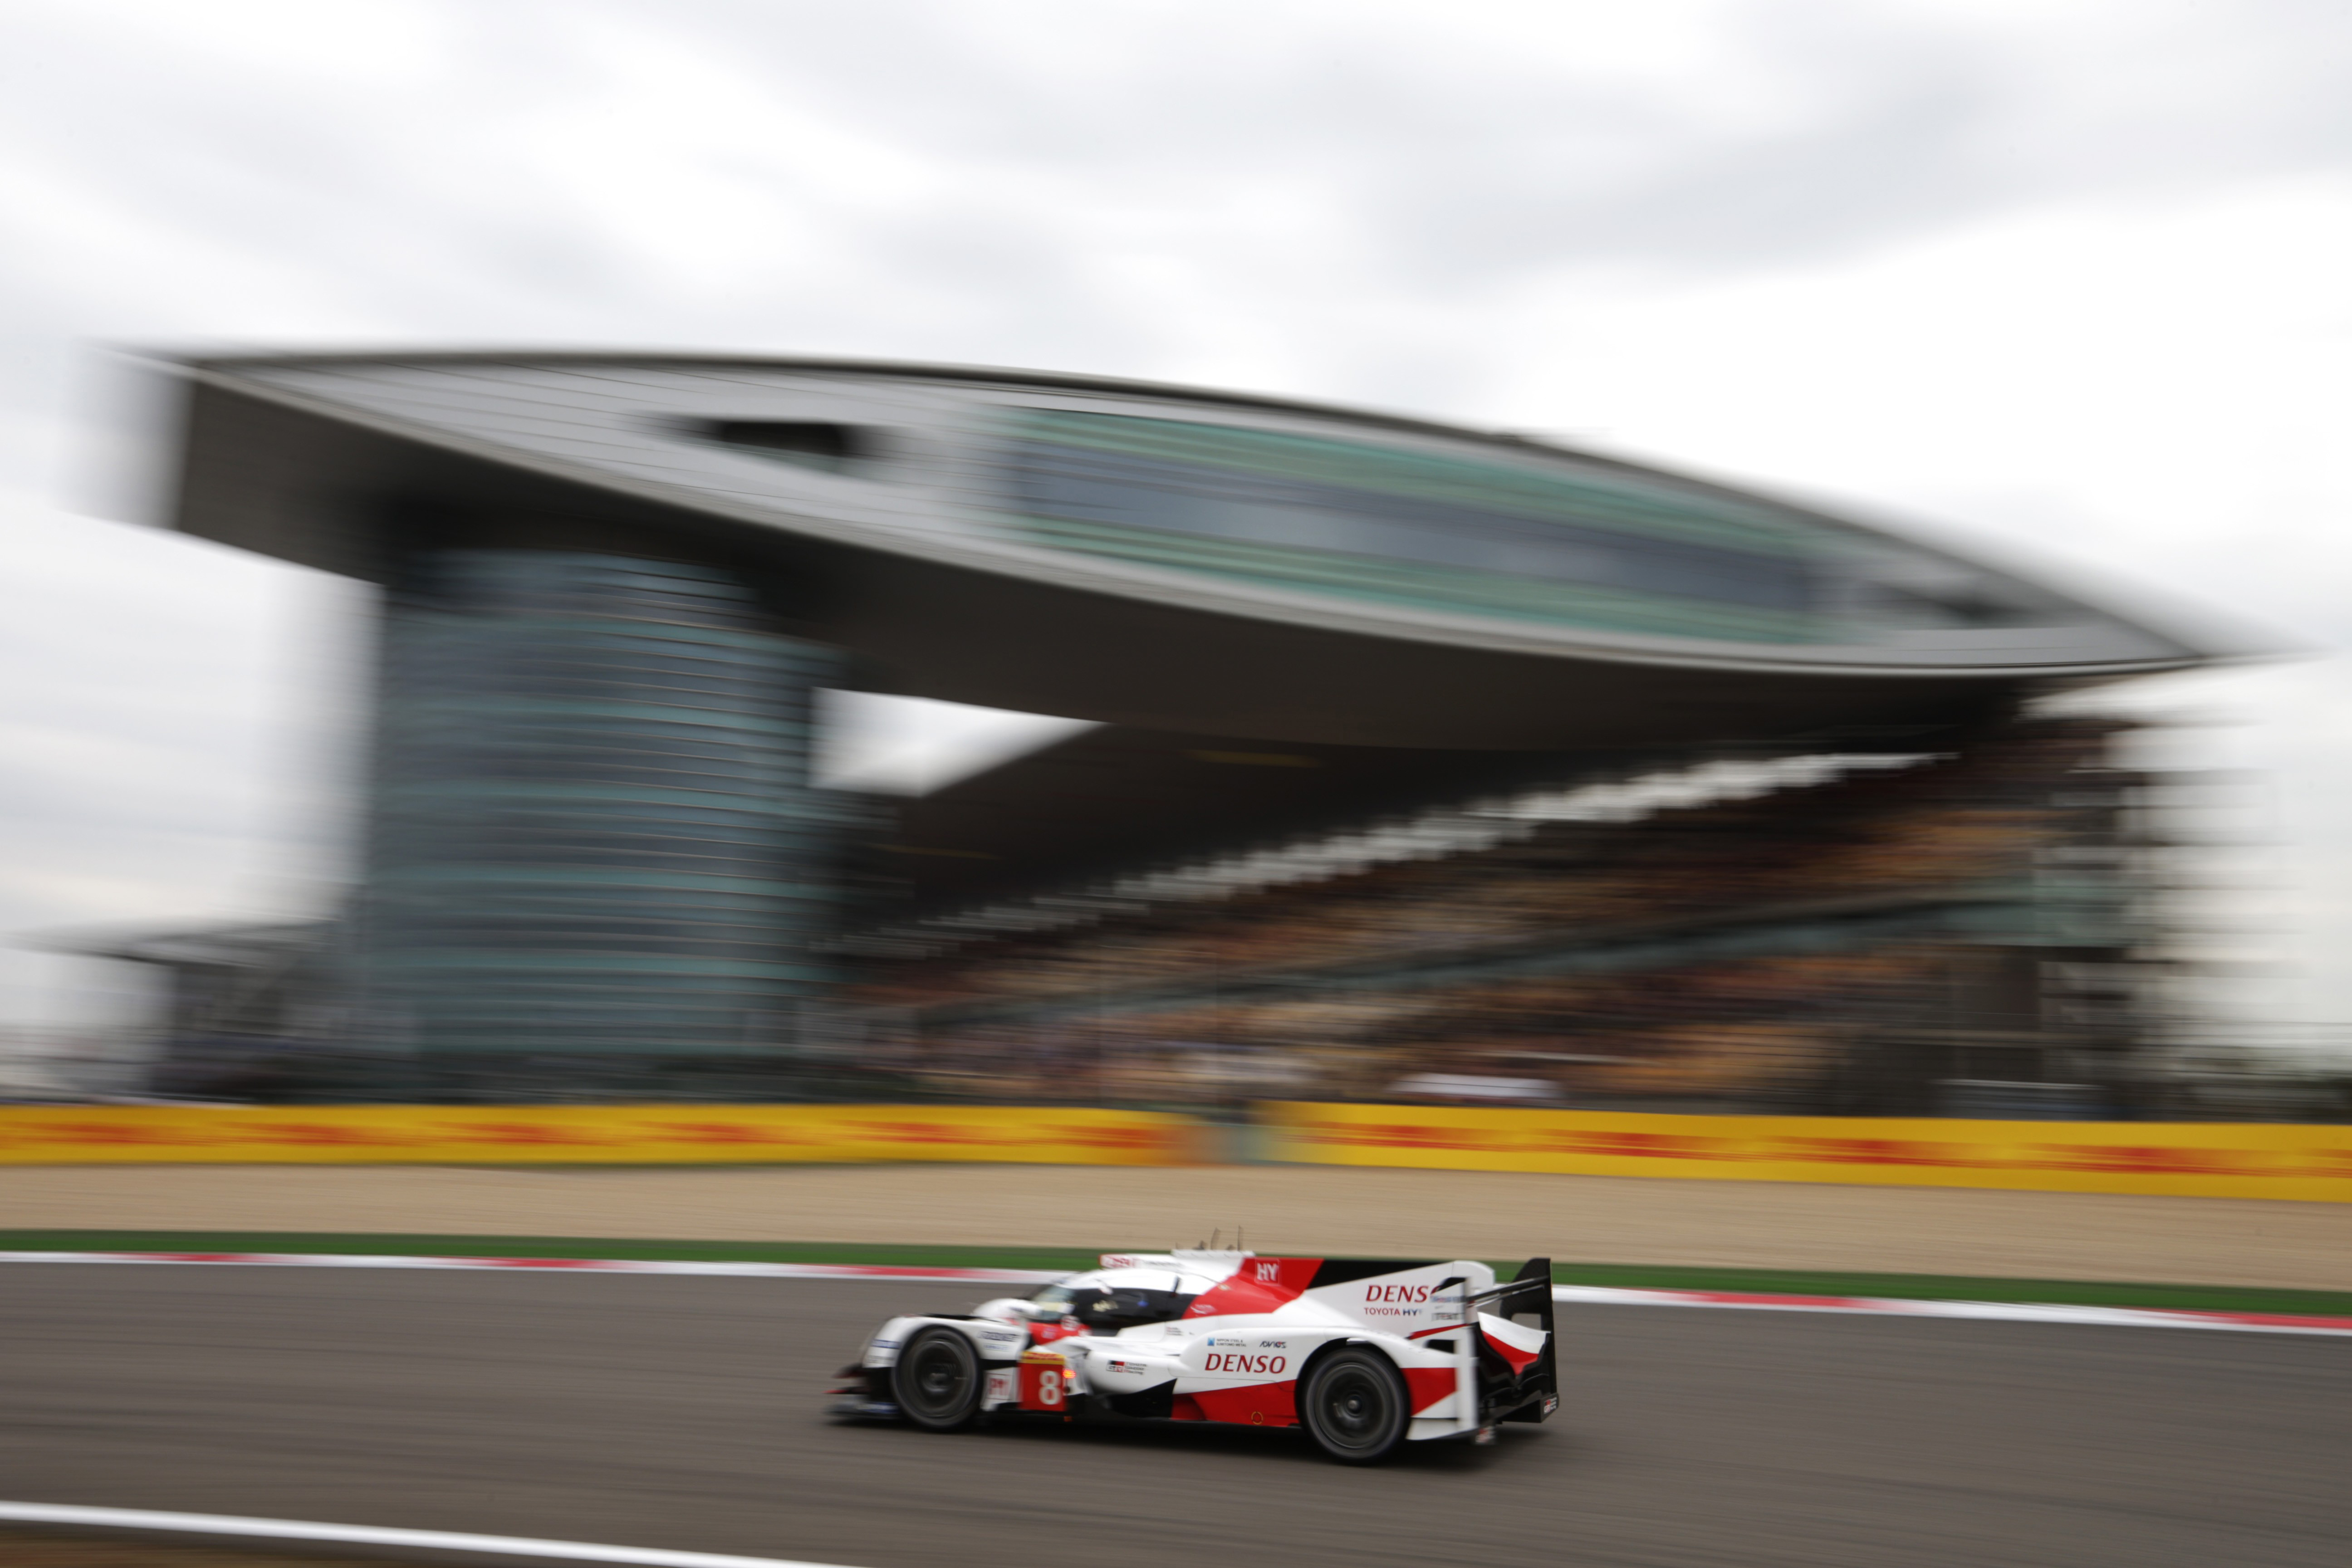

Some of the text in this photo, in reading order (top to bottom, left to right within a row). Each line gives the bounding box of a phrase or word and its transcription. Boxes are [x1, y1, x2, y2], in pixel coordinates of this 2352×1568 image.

[1257, 1263, 1277, 1282] HY
[1364, 1308, 1400, 1316] TOYOTA
[1205, 1353, 1286, 1374] DENSO
[1039, 1370, 1062, 1405] 8
